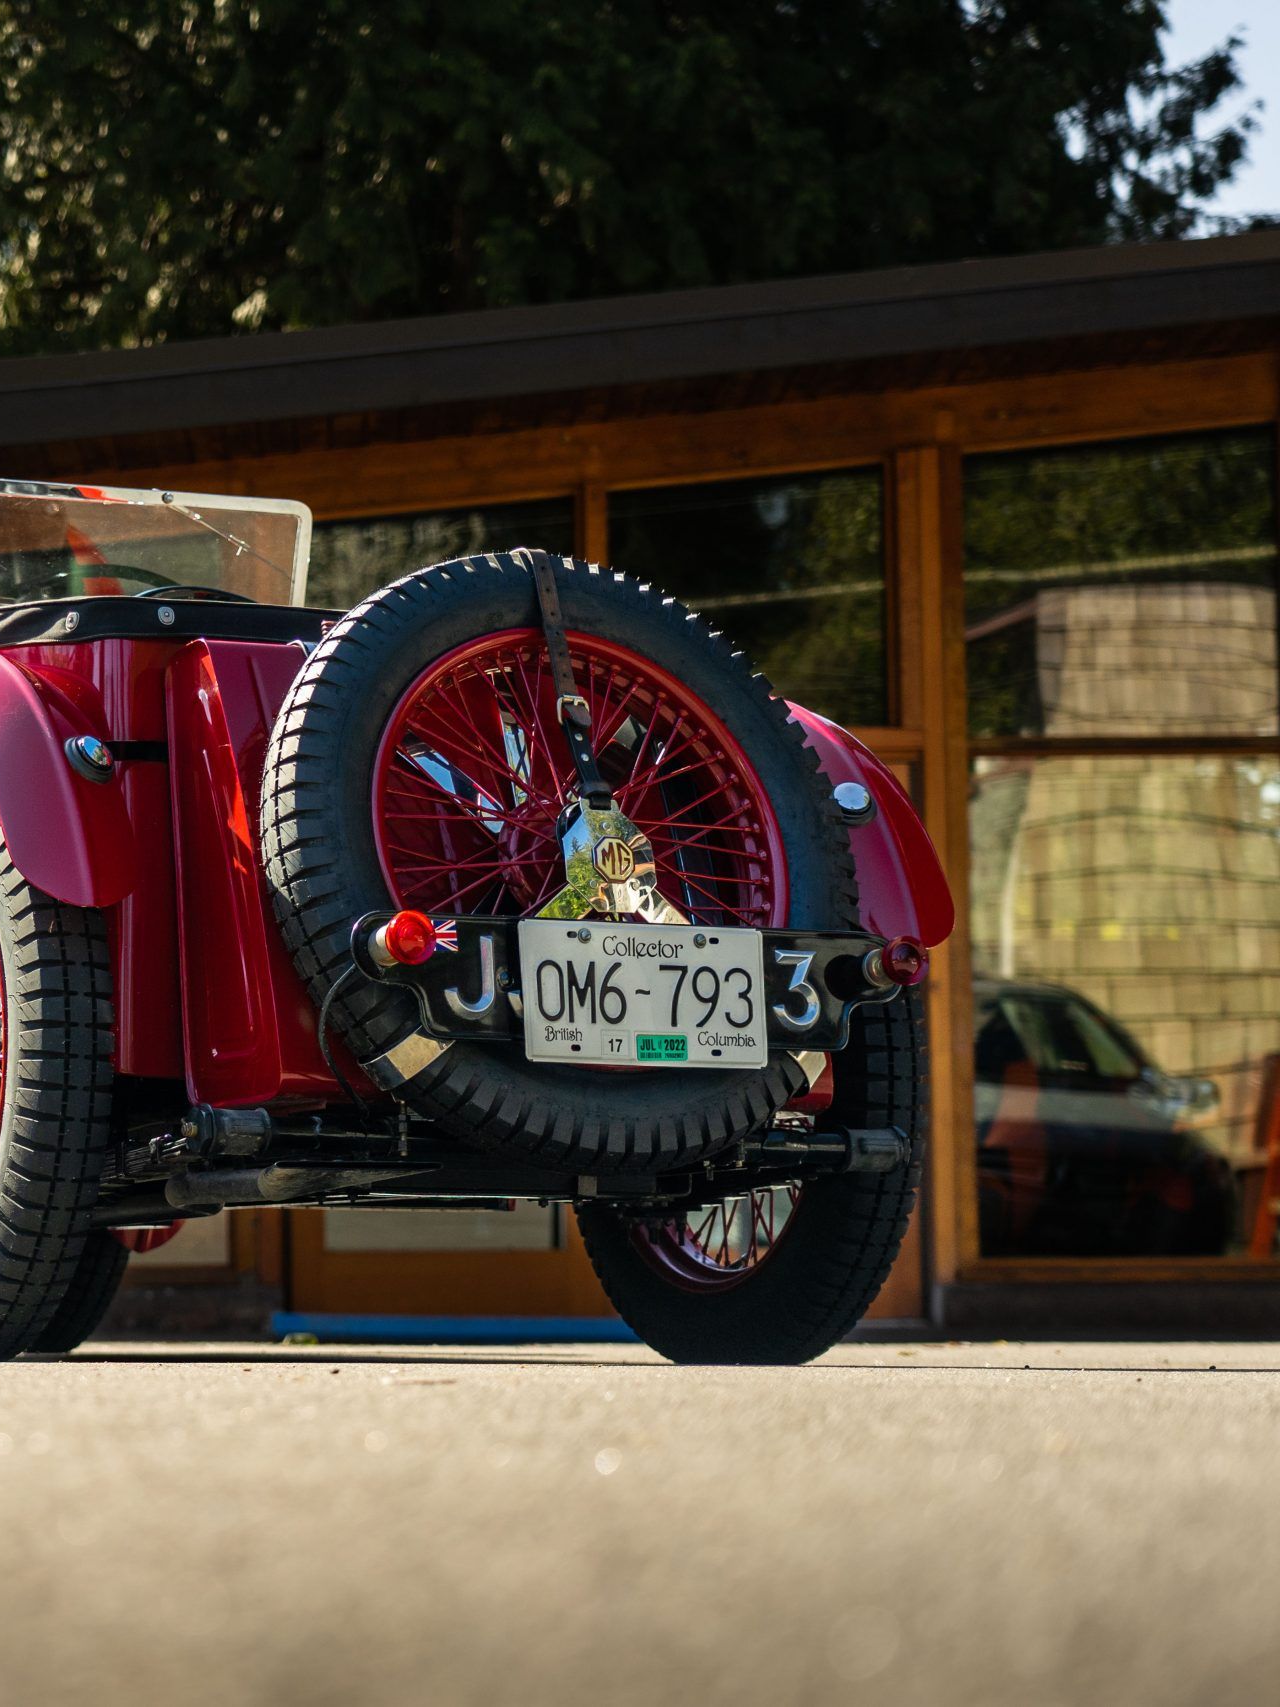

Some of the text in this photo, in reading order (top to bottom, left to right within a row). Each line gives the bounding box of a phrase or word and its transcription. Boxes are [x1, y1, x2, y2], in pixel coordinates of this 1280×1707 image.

[601, 841, 632, 876] MG
[602, 935, 684, 959] Collector
[544, 1025, 583, 1042] British
[697, 1030, 757, 1047] Columbia
[608, 1038, 623, 1053] 17
[640, 1038, 686, 1051] JUL 2022
